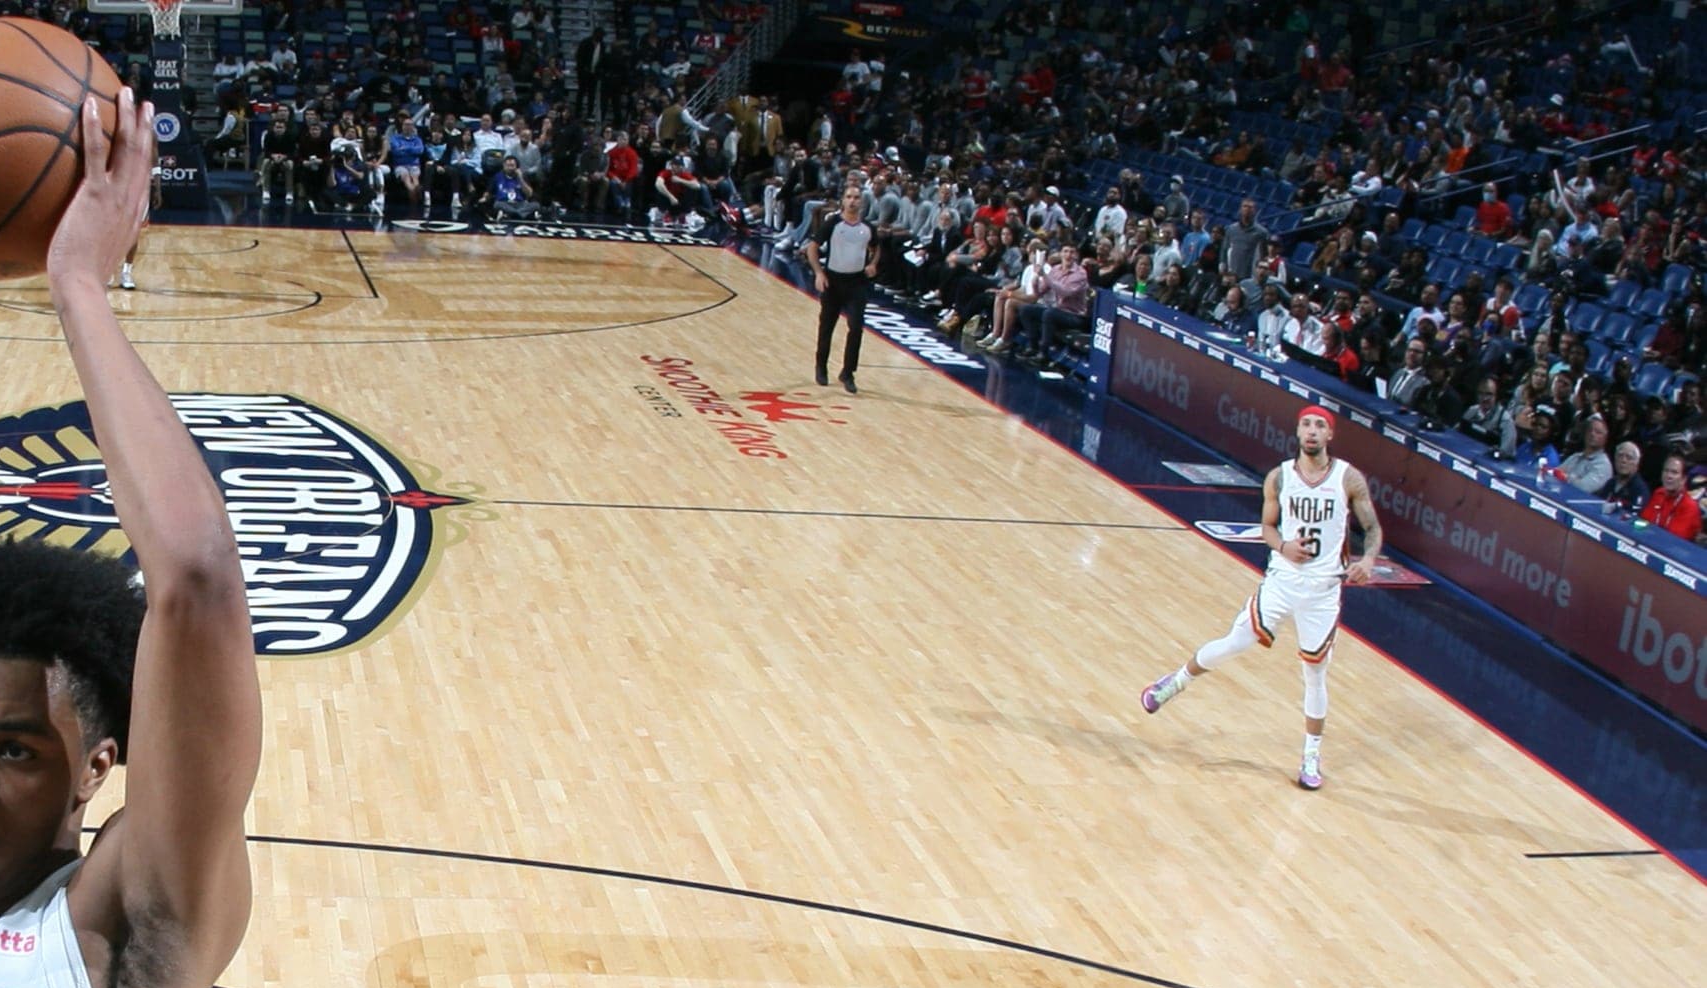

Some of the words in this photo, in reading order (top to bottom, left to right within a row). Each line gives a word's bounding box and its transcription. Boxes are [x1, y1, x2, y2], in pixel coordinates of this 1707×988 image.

[154, 69, 178, 78] GEEK
[155, 60, 178, 69] SEAT
[161, 168, 197, 180] SOT
[640, 355, 742, 418] SMOOTHIE
[1122, 338, 1190, 411] ibotta
[634, 384, 682, 418] CENTER
[1218, 393, 1259, 439] Cash
[1264, 416, 1299, 459] bac
[1369, 474, 1444, 540] oceries
[1450, 520, 1498, 566] and
[1501, 547, 1572, 608] more
[1289, 495, 1335, 523] NOLA
[1618, 584, 1707, 699] ibot
